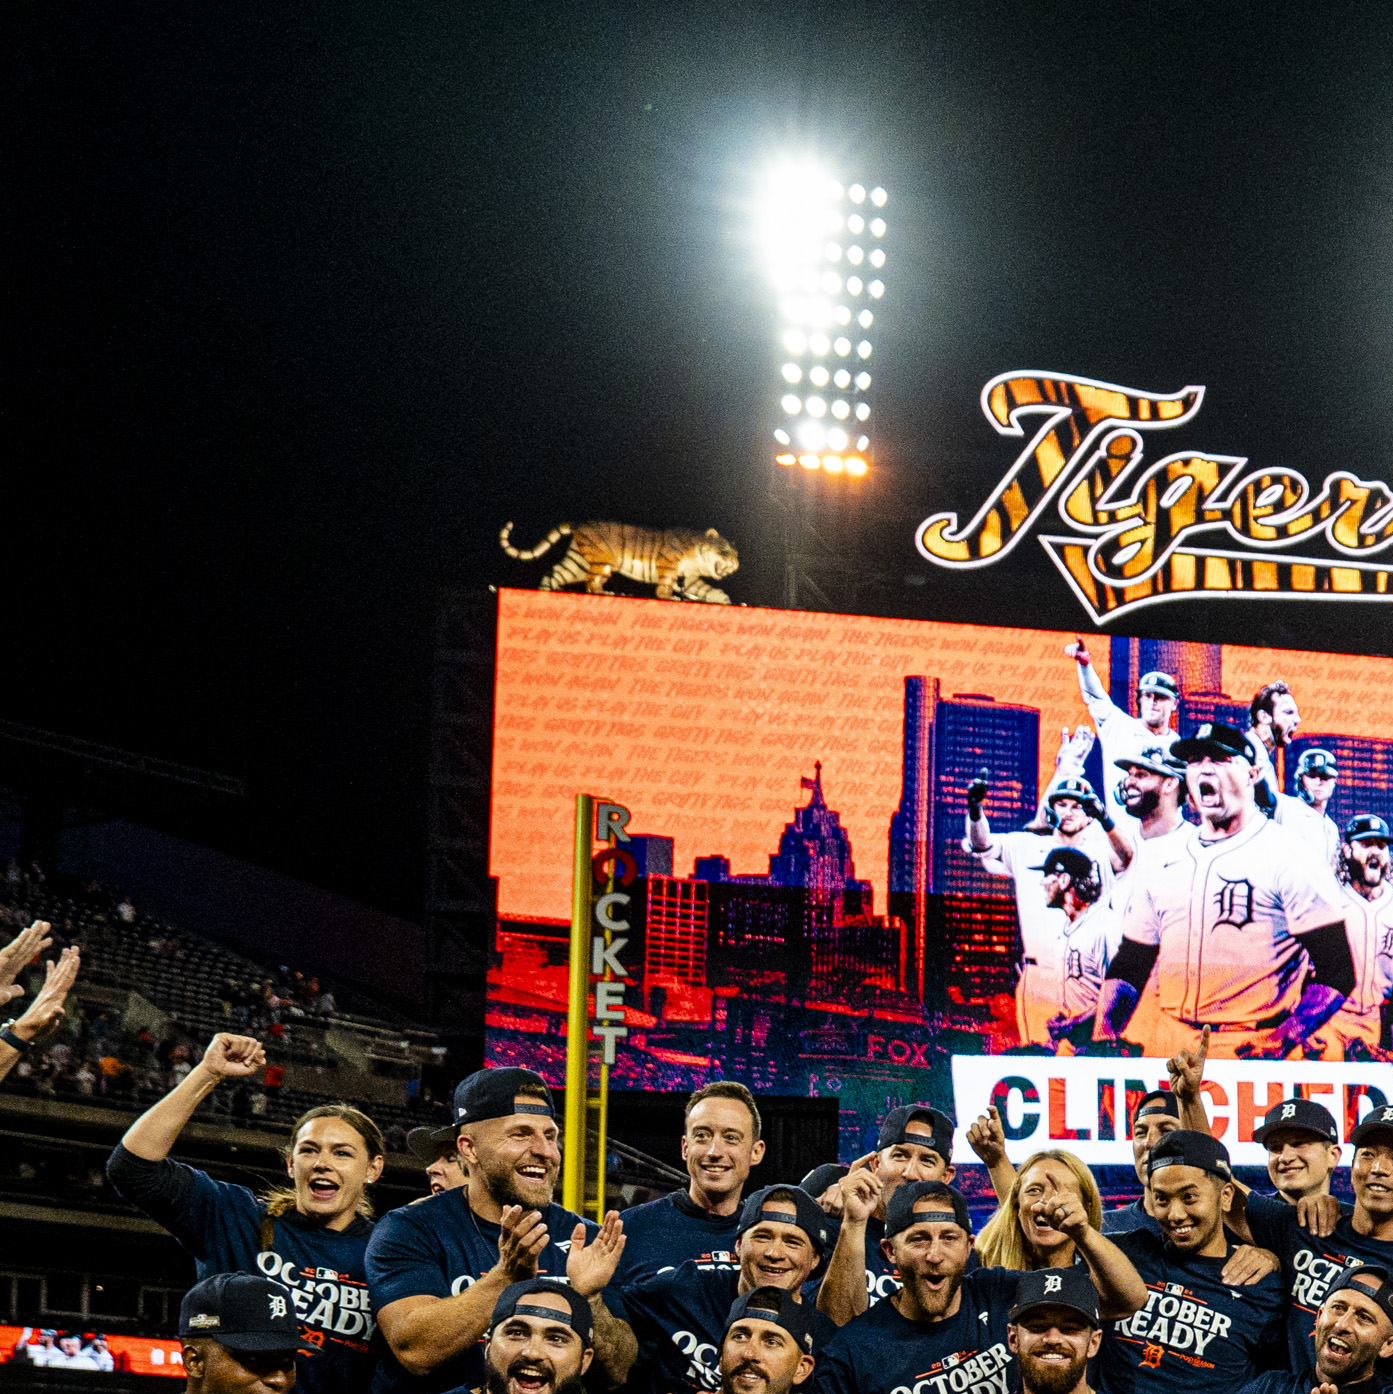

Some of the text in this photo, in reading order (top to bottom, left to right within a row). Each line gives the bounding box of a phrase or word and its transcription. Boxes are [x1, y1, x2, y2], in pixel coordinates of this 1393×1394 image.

[592, 803, 638, 1066] ROCKET
[868, 1036, 931, 1069] FOX
[990, 1076, 1389, 1144] CLINCHD
[256, 1251, 371, 1311] OCOBE
[291, 1288, 377, 1341] EADY
[1144, 1290, 1232, 1339] TOBER
